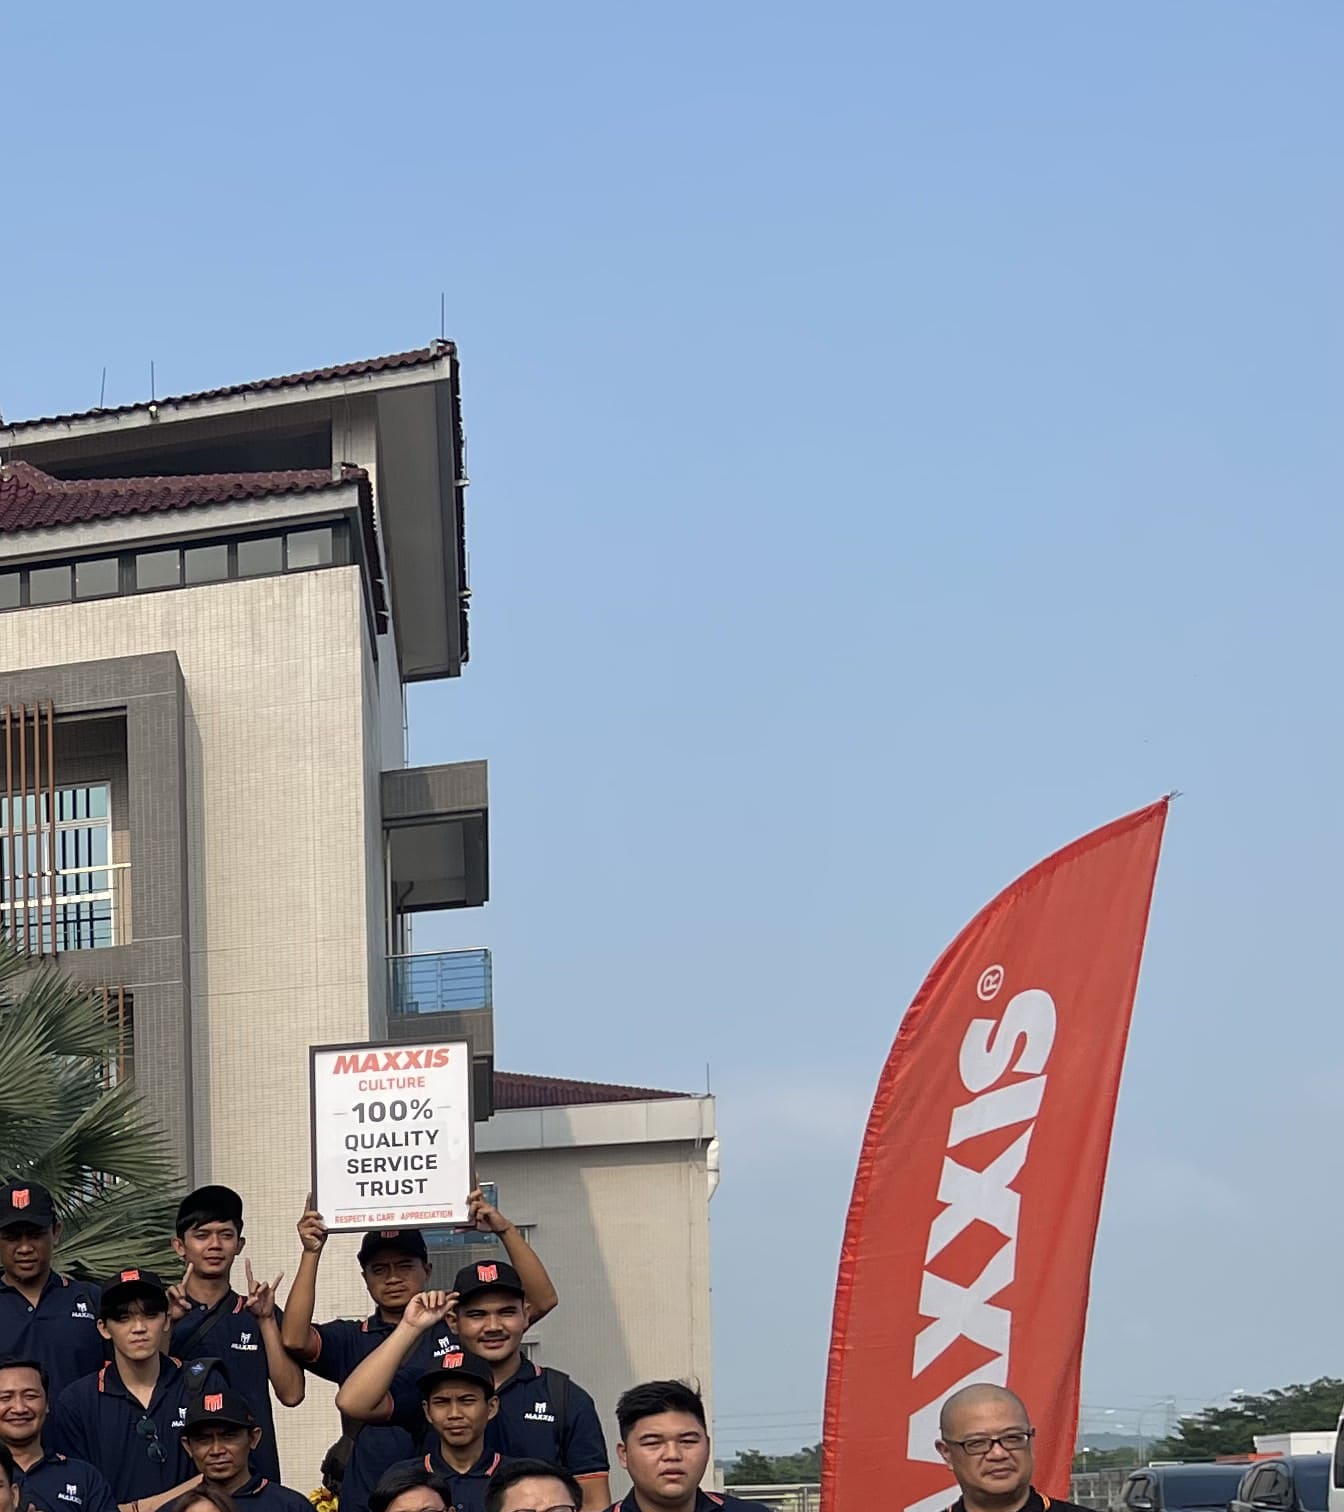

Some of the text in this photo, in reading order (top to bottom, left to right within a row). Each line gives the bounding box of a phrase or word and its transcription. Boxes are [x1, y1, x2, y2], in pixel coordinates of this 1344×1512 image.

[333, 1048, 449, 1075] MAXXIS
[358, 1076, 425, 1091] CULTURE
[352, 1098, 433, 1123] 100%
[345, 1129, 439, 1152] QUALITY
[346, 1154, 438, 1174] SERVICE
[356, 1178, 428, 1197] TRUST
